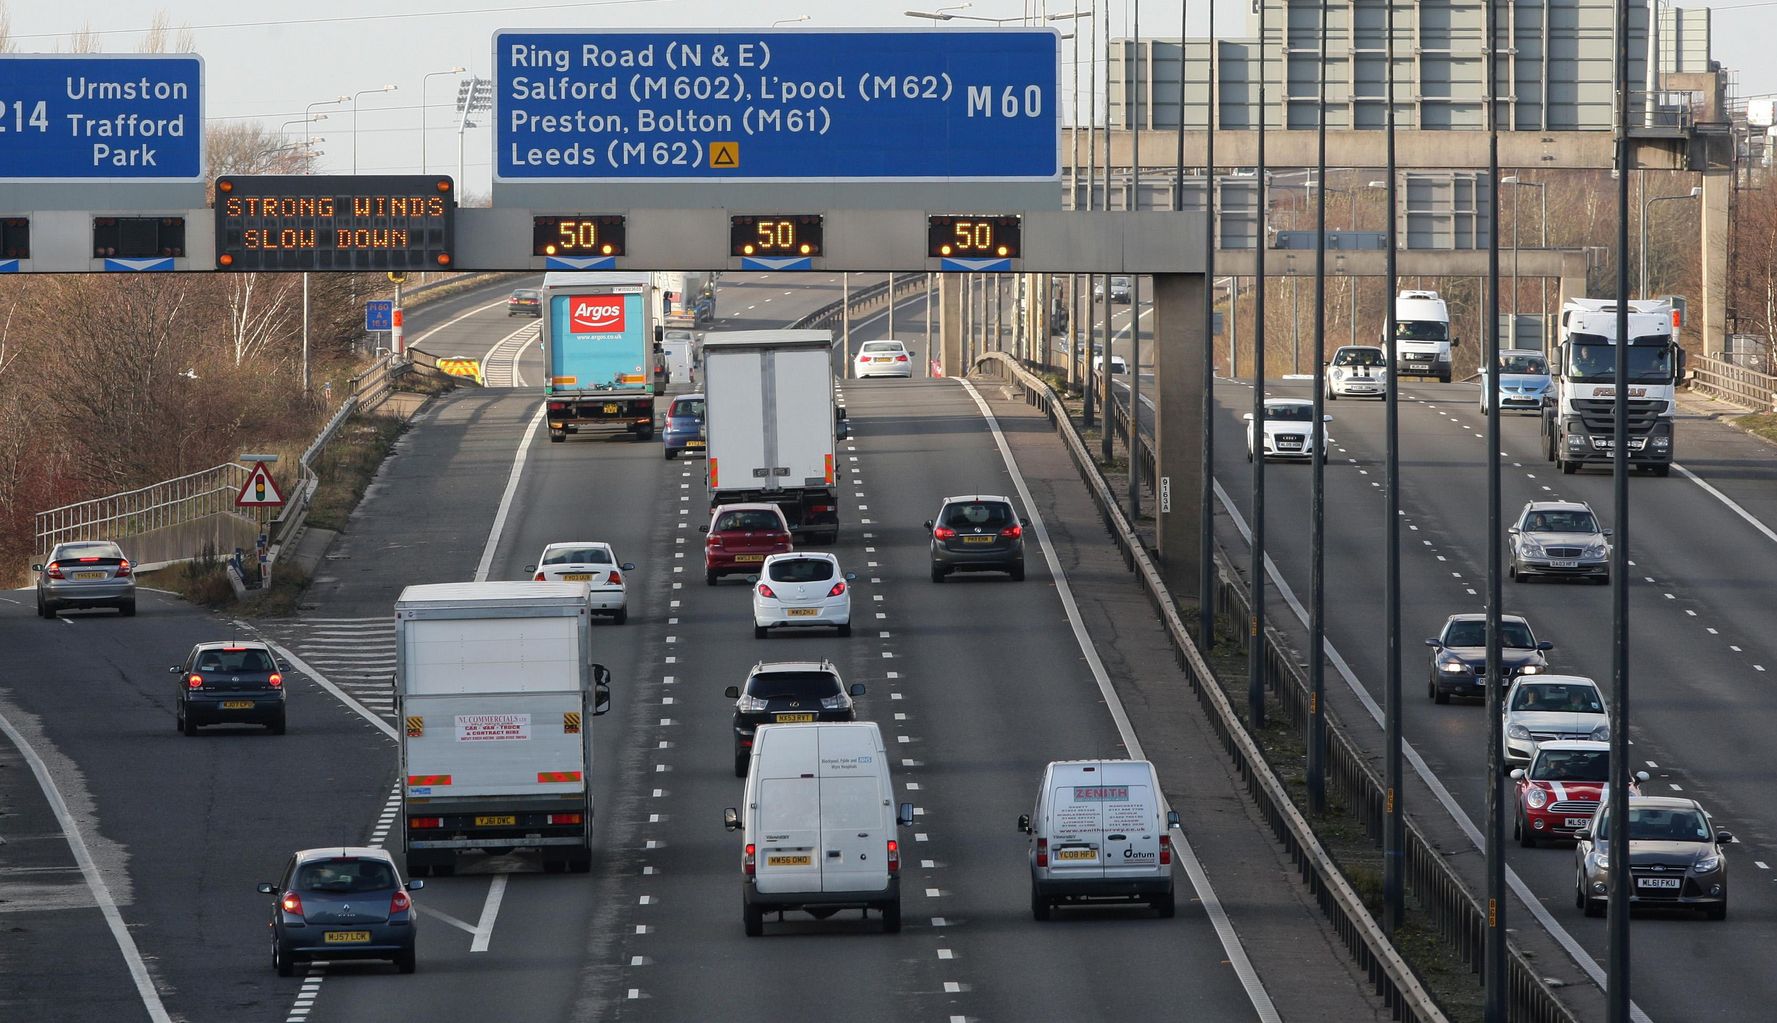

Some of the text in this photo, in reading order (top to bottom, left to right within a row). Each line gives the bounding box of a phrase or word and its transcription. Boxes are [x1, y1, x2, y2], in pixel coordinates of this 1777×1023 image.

[512, 41, 770, 71] Ring Road (N & E)
[67, 77, 187, 99] Urmston
[512, 77, 616, 99] Salford
[762, 77, 845, 103] L'pool
[968, 85, 1041, 117] M60
[67, 114, 183, 136] Trafford
[512, 110, 628, 133] Preston,
[639, 110, 731, 132] Bolton
[94, 144, 156, 166] Park
[513, 143, 595, 165] Leeds
[228, 198, 442, 216] STRONG WINDS
[246, 230, 405, 248] SLOW DOWN
[561, 222, 594, 247] 50
[759, 222, 792, 247] 50
[957, 223, 990, 249] 50
[574, 302, 621, 321] Argos
[576, 334, 623, 343] www.argos.co.uk
[1075, 788, 1128, 798] ZENITH
[1059, 850, 1079, 859] YC08
[1123, 842, 1155, 859] datum
[1642, 879, 1676, 887] ML61 FKU
[328, 933, 349, 941] MJ57
